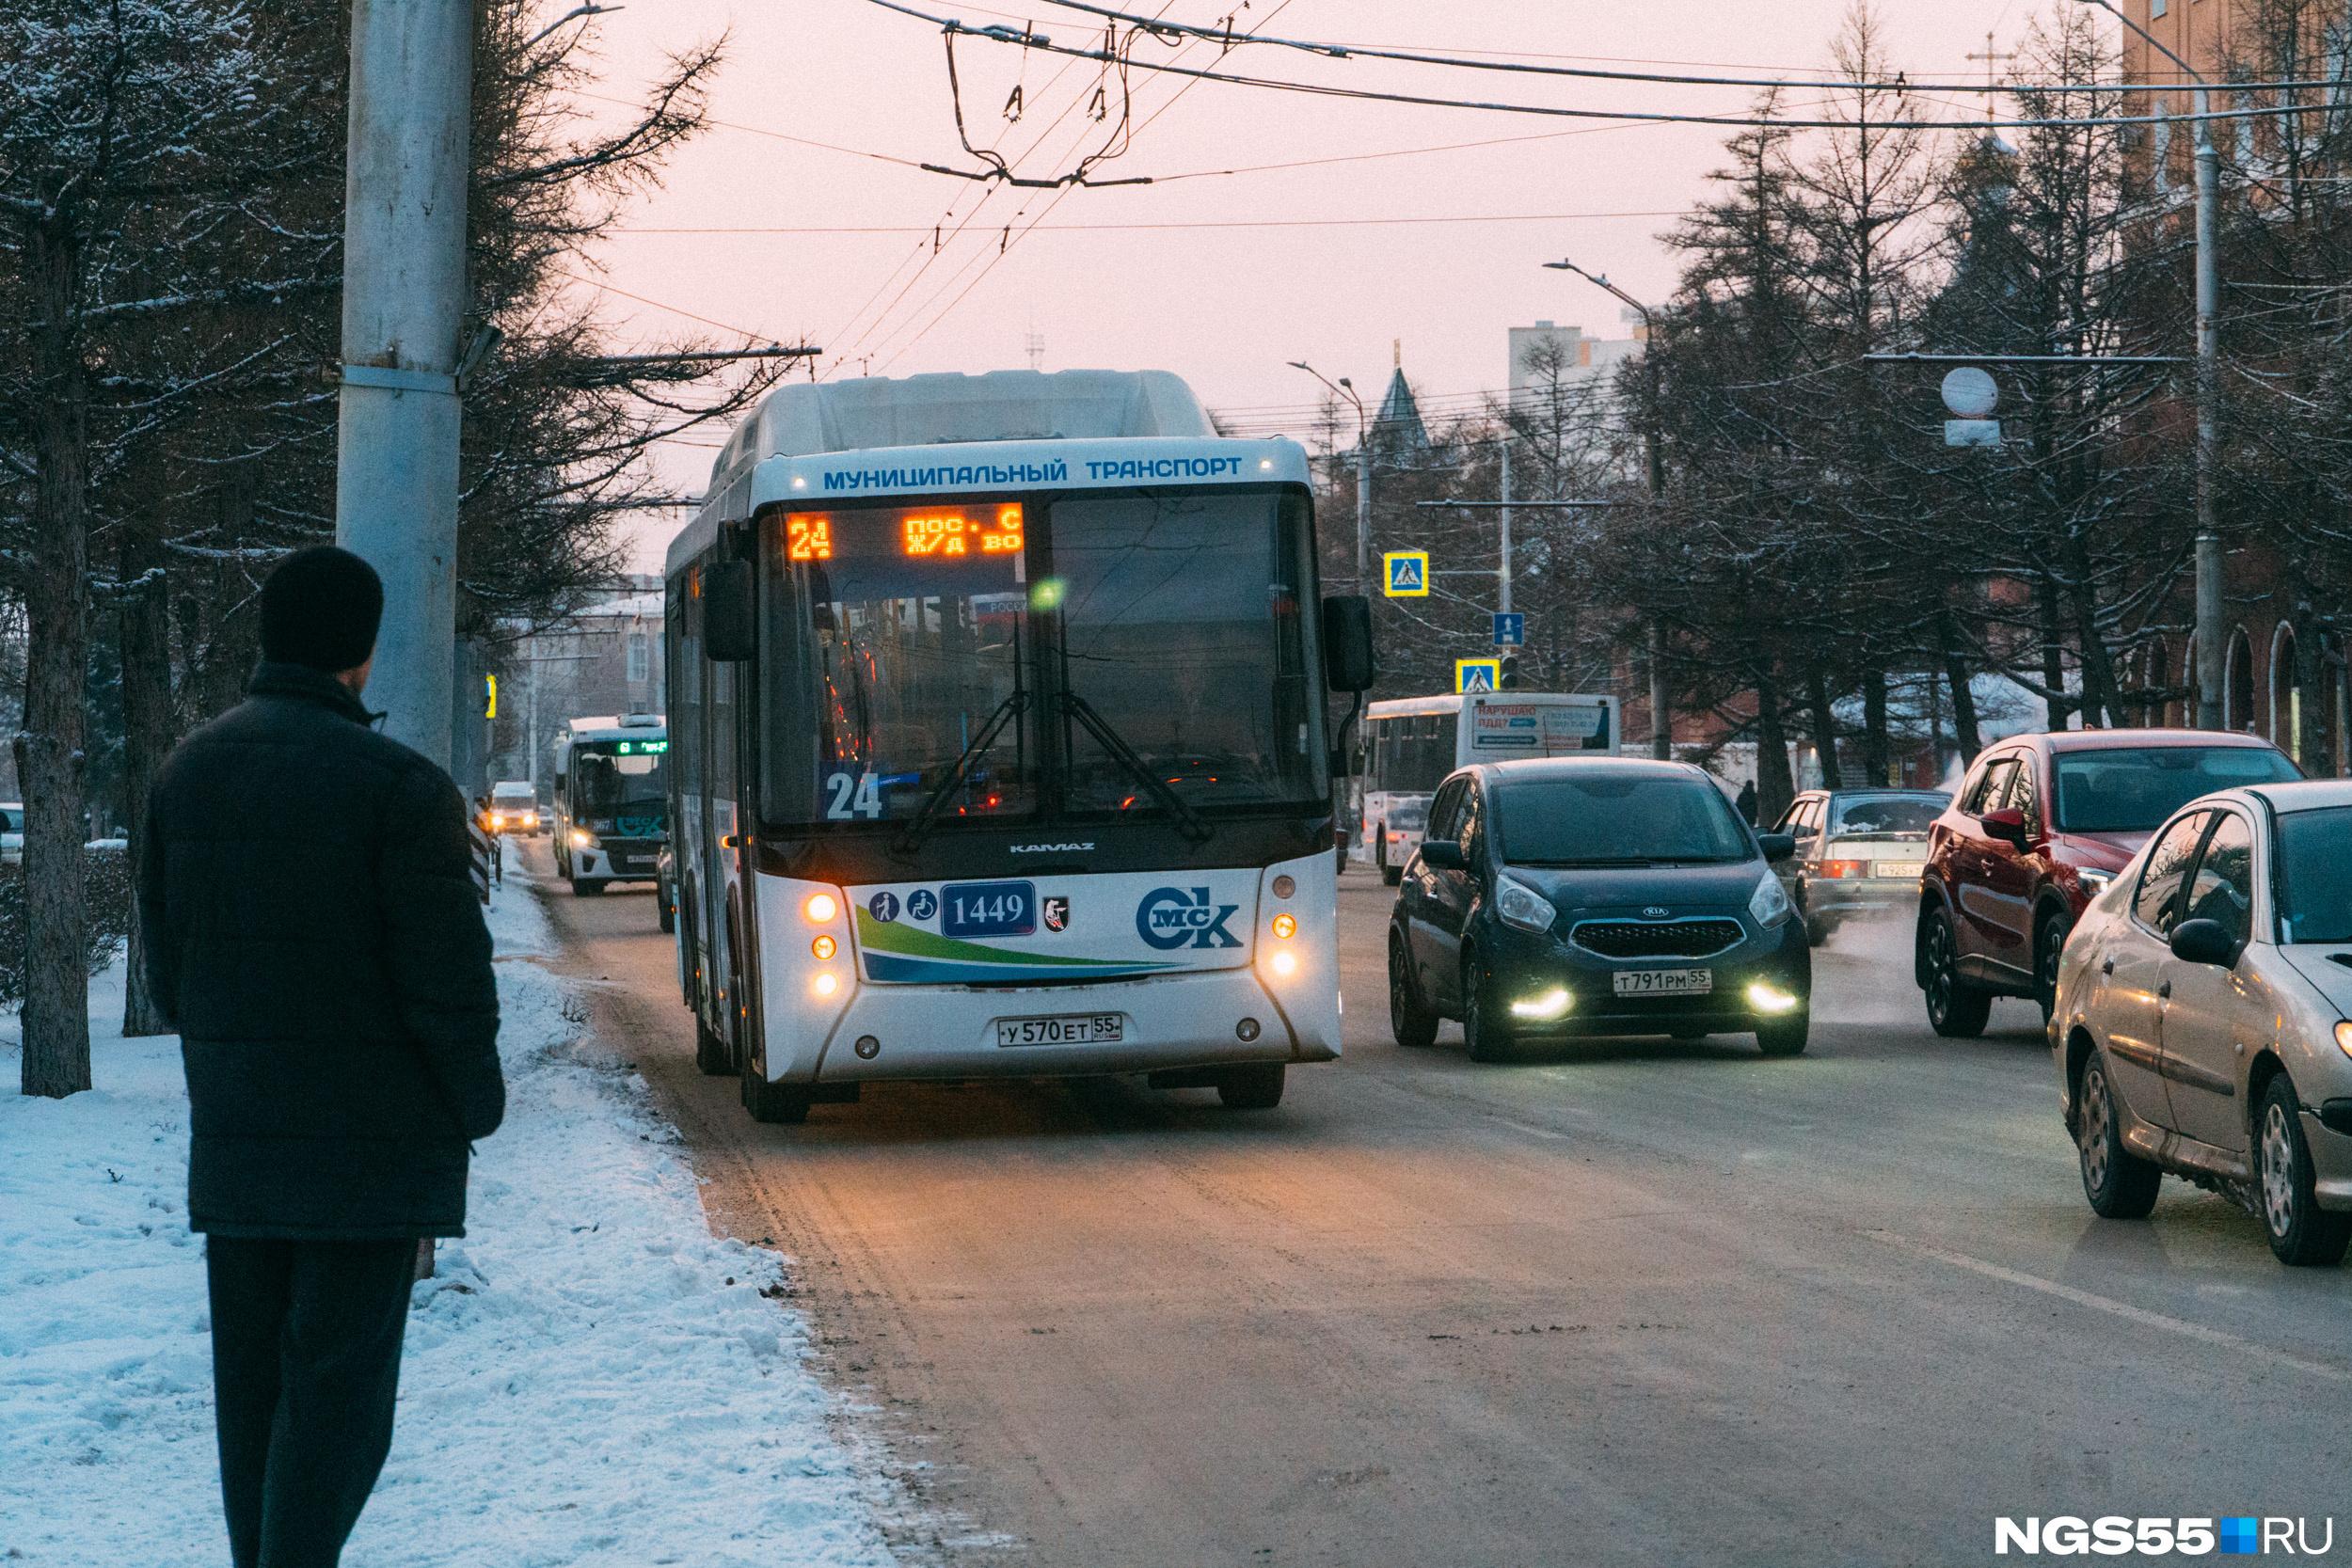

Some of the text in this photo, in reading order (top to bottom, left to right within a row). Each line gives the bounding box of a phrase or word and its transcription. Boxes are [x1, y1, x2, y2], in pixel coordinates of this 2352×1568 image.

[824, 457, 1242, 490] МУНИЦИПАЛЬНЫЙ ТРАНСПОРТ
[791, 521, 829, 558] 24
[827, 772, 882, 819] 24
[1010, 843, 1094, 853] KAMAZ
[953, 895, 1024, 925] 1449
[1094, 1018, 1114, 1033] 55
